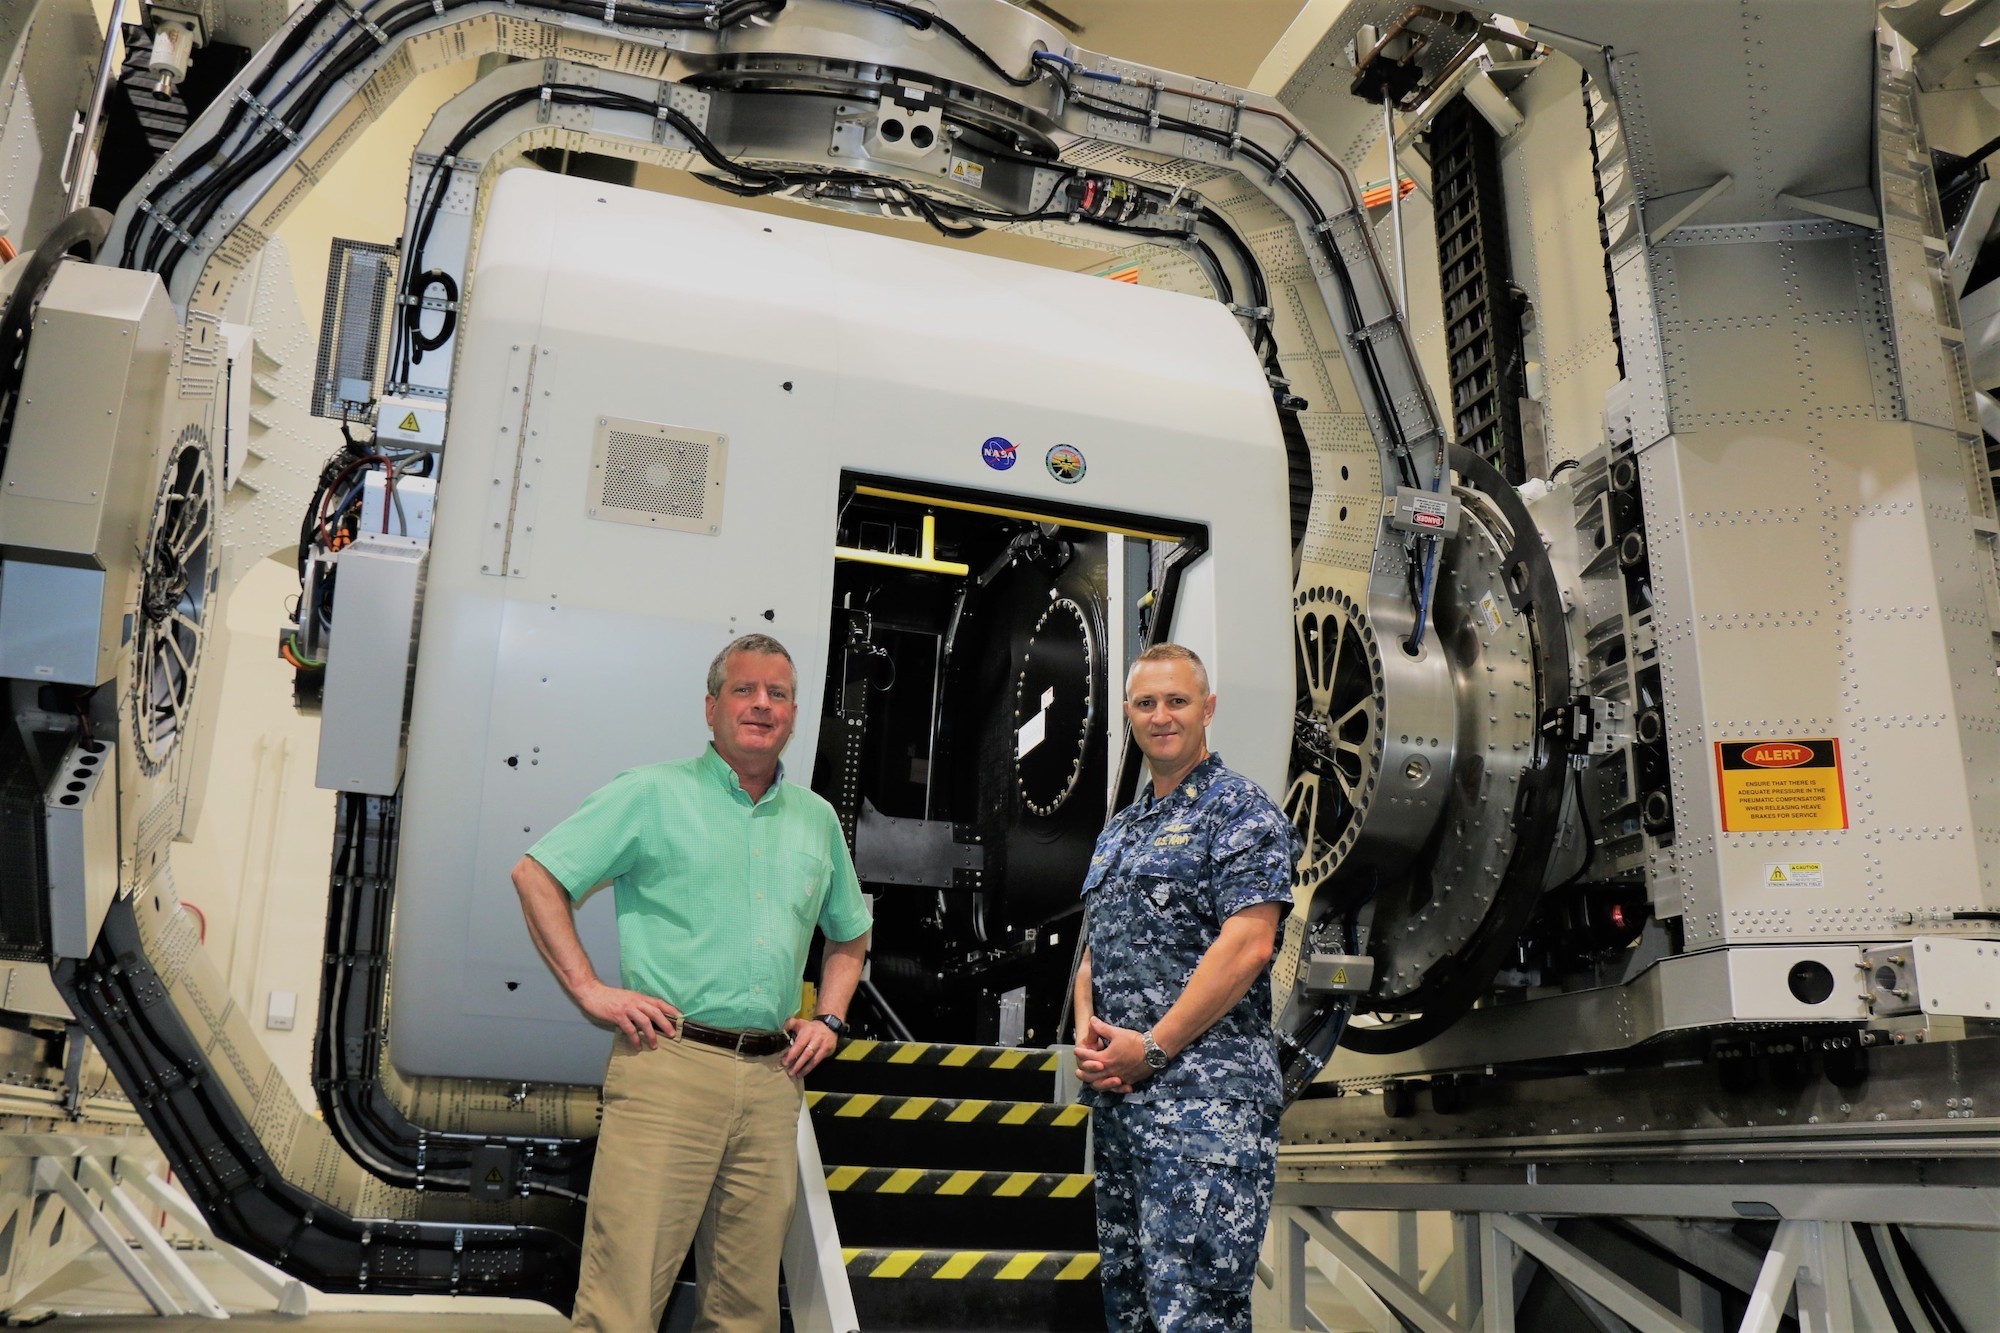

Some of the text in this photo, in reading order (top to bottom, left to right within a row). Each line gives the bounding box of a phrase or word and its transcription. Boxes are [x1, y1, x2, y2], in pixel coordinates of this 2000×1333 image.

[984, 448, 1015, 460] NASA
[1416, 515, 1441, 525] DANGER
[1755, 749, 1801, 761] ALERT
[1169, 833, 1190, 846] NAVY
